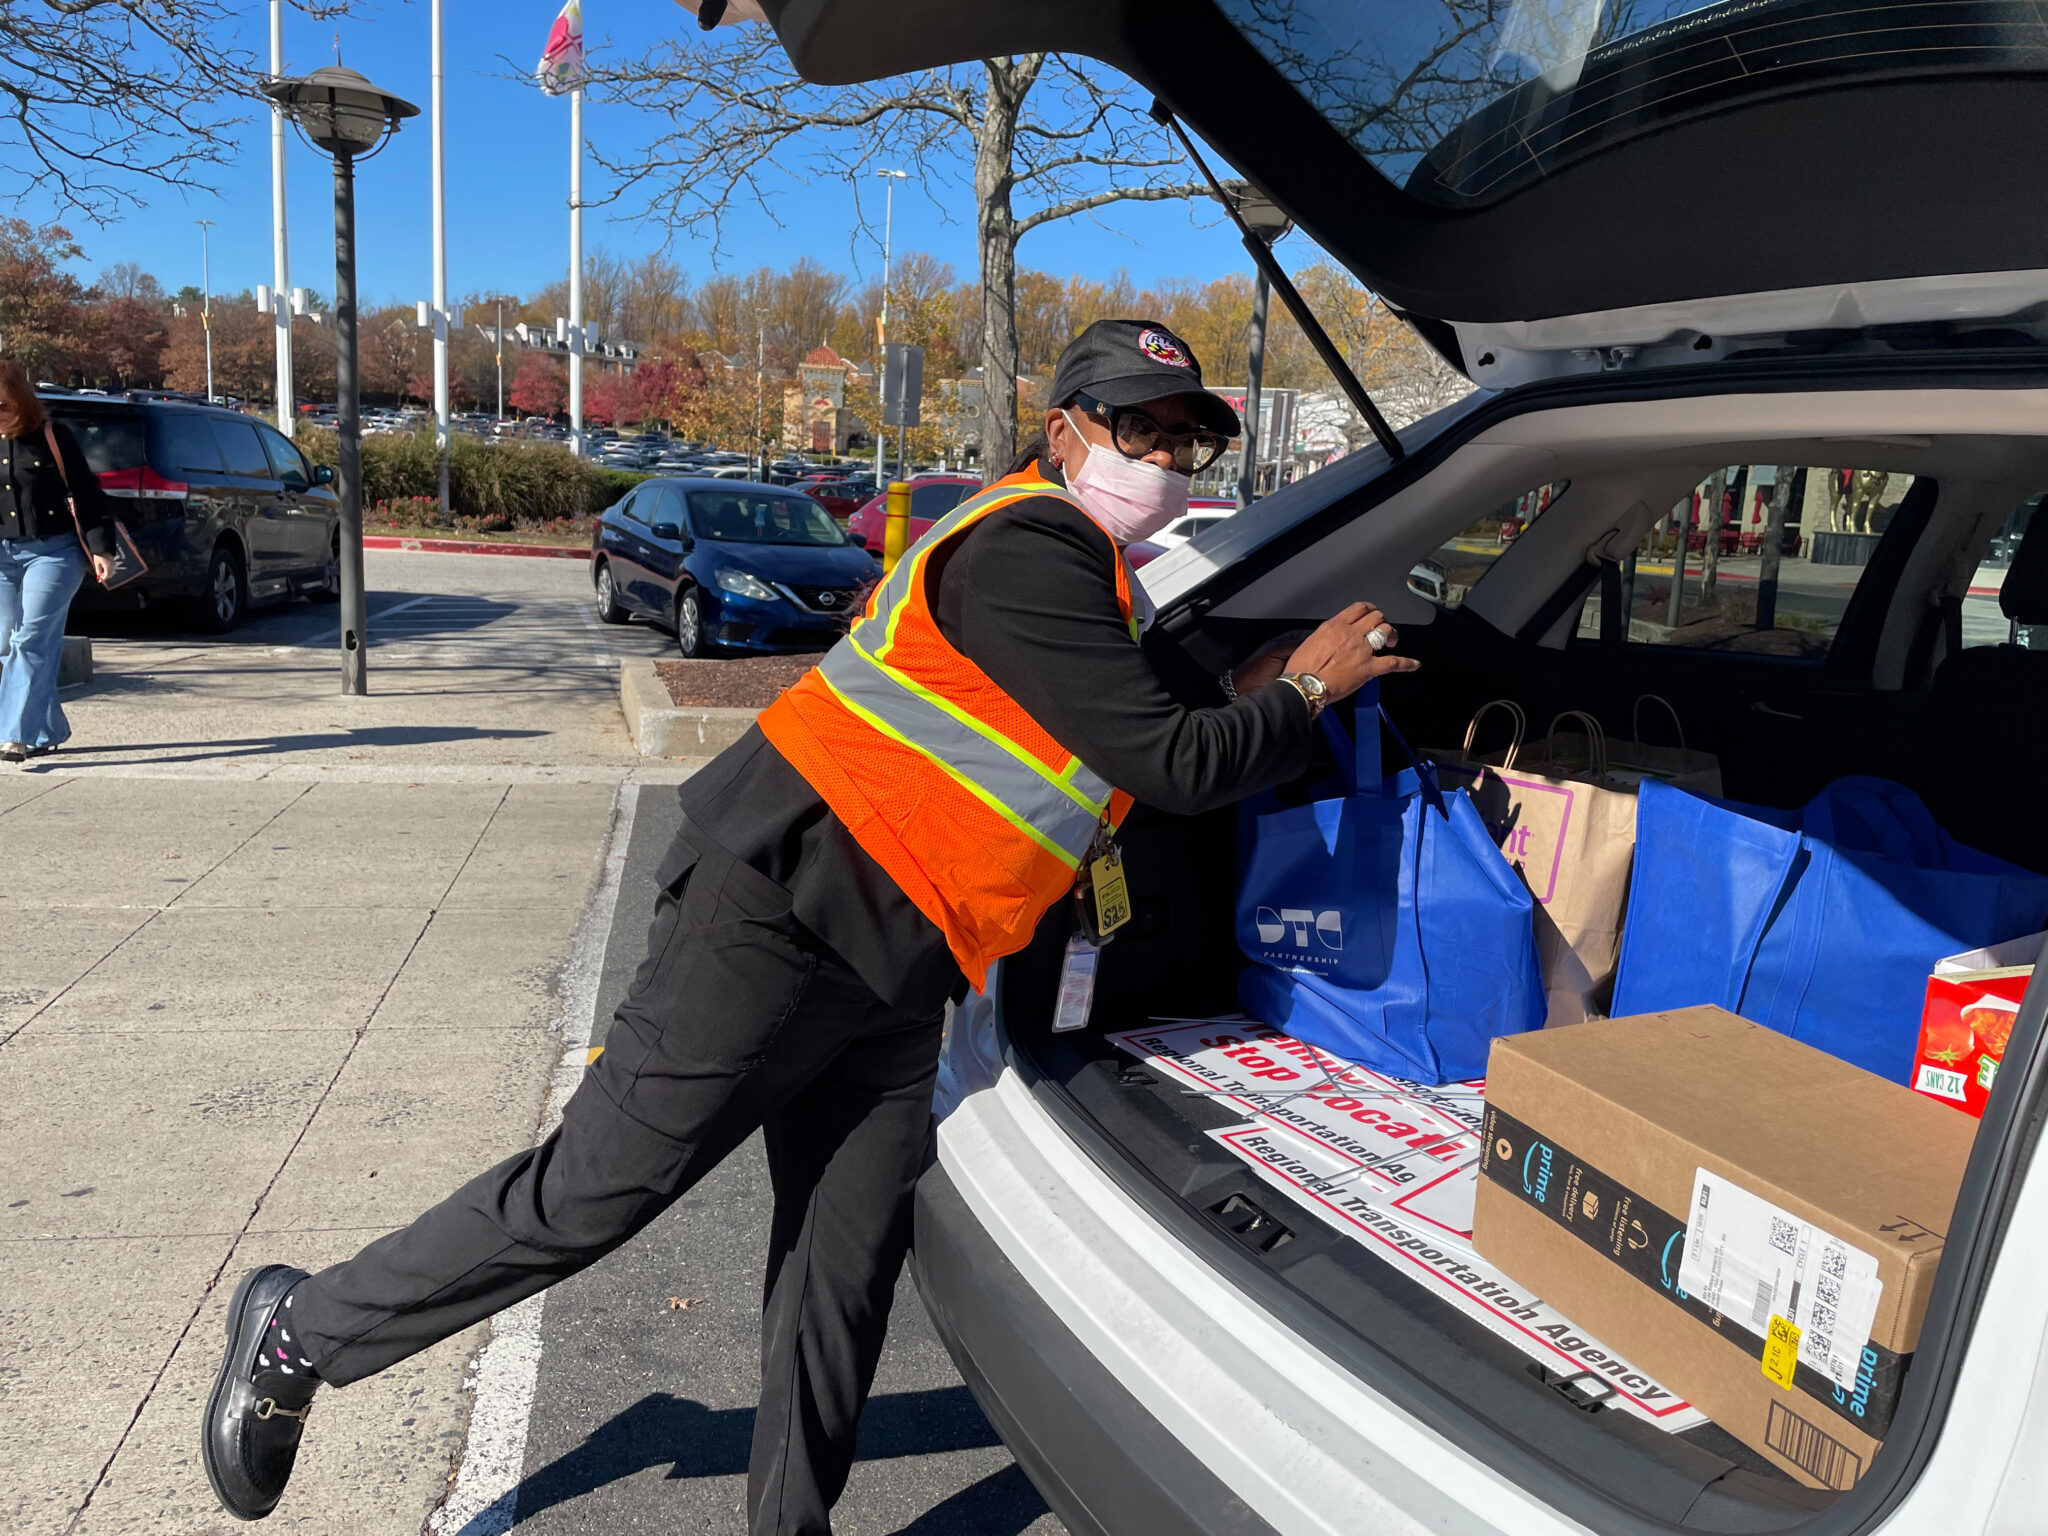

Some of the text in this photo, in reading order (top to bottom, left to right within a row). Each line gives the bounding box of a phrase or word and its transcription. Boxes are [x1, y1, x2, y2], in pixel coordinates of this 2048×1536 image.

[1151, 335, 1176, 346] RTA
[1263, 951, 1339, 965] PARTNERSHIP
[1200, 1035, 1301, 1081] Stop
[1925, 1069, 1961, 1094] 12 CANS
[1140, 1037, 1228, 1081] Regional
[1223, 1080, 1383, 1162] Transportation
[1535, 1143, 1553, 1203] prime
[1566, 1167, 1583, 1222] free delivery
[1613, 1196, 1632, 1256] free listening
[1240, 1136, 1673, 1401] Regional Transportation Agency
[1797, 1249, 1805, 1269] CYCLE
[1850, 1345, 1878, 1418] prime
